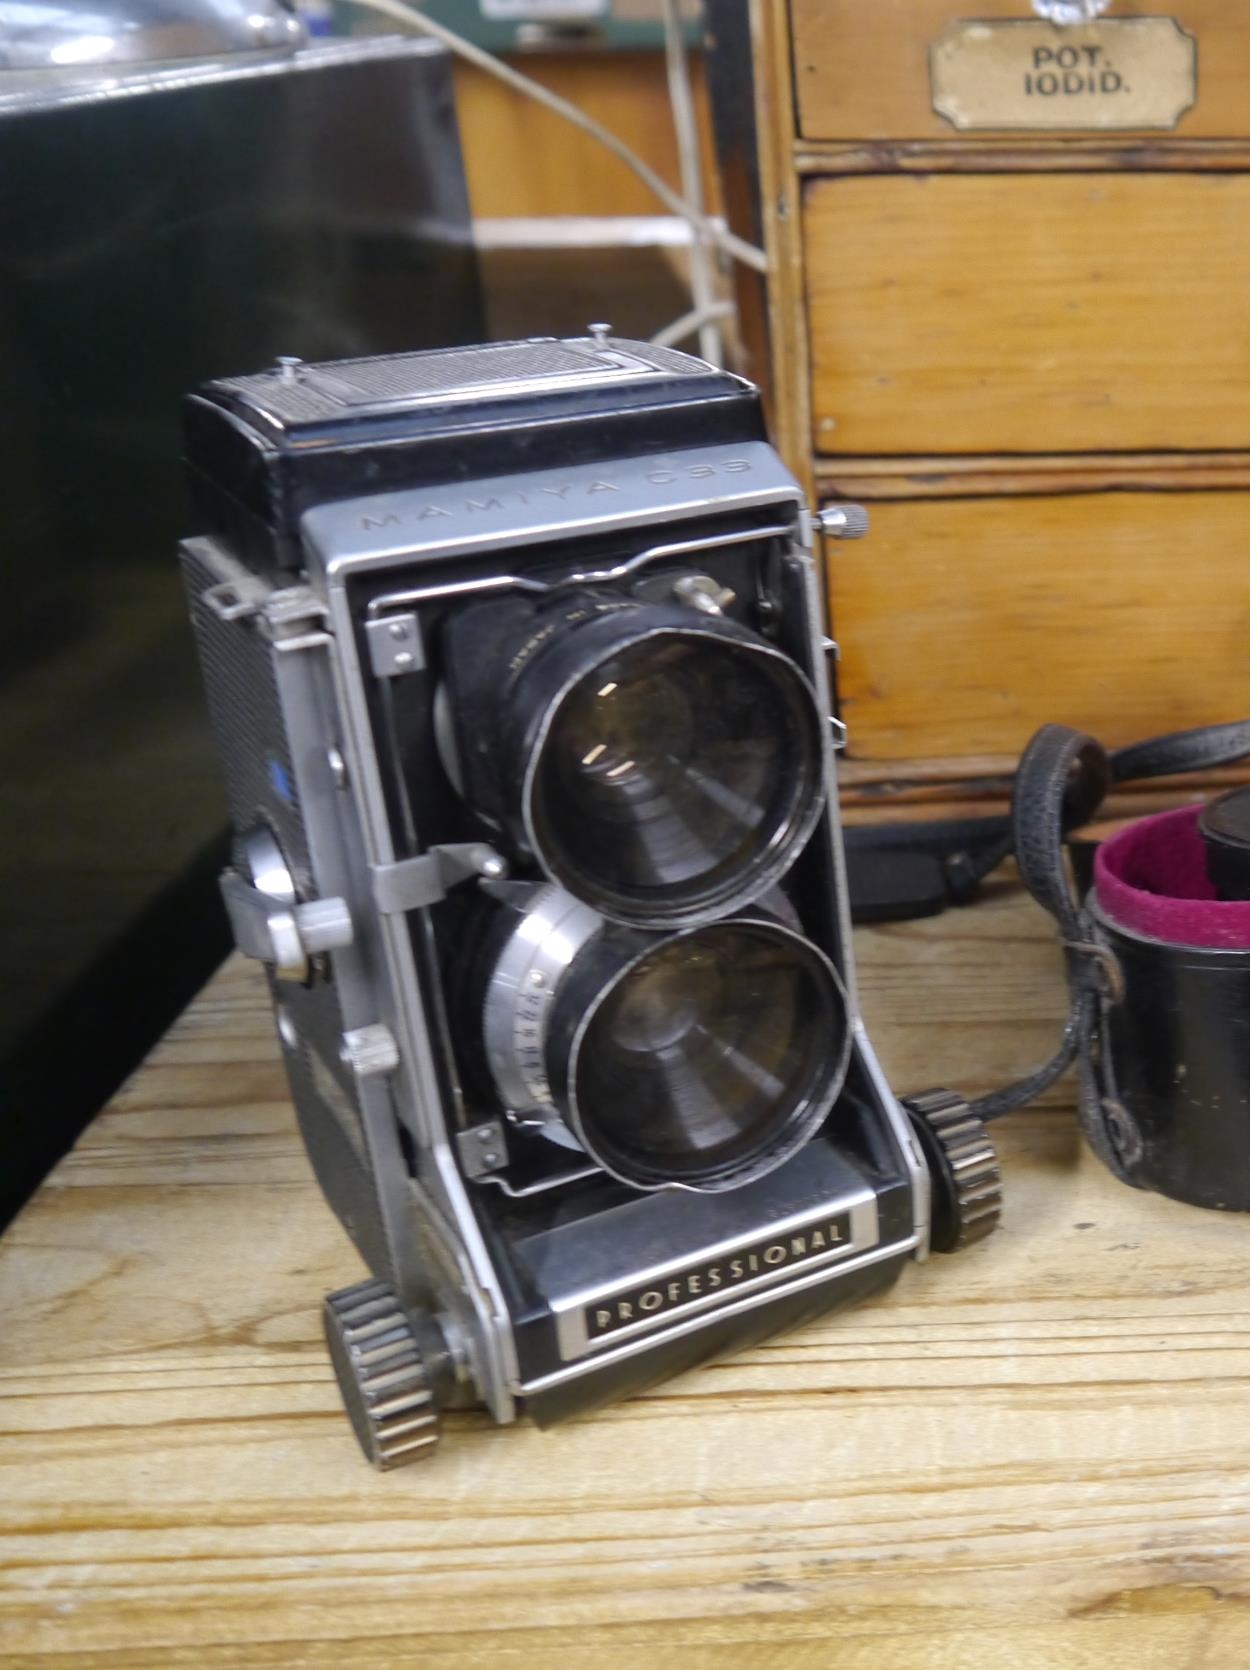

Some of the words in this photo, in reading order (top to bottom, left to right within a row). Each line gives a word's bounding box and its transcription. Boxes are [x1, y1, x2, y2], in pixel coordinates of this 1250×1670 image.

[1032, 46, 1112, 70] POT.
[1024, 70, 1131, 97] IODID.
[360, 480, 621, 532] MAMIYA
[645, 458, 753, 486] C33
[596, 1224, 844, 1329] PROFESSIONAL
